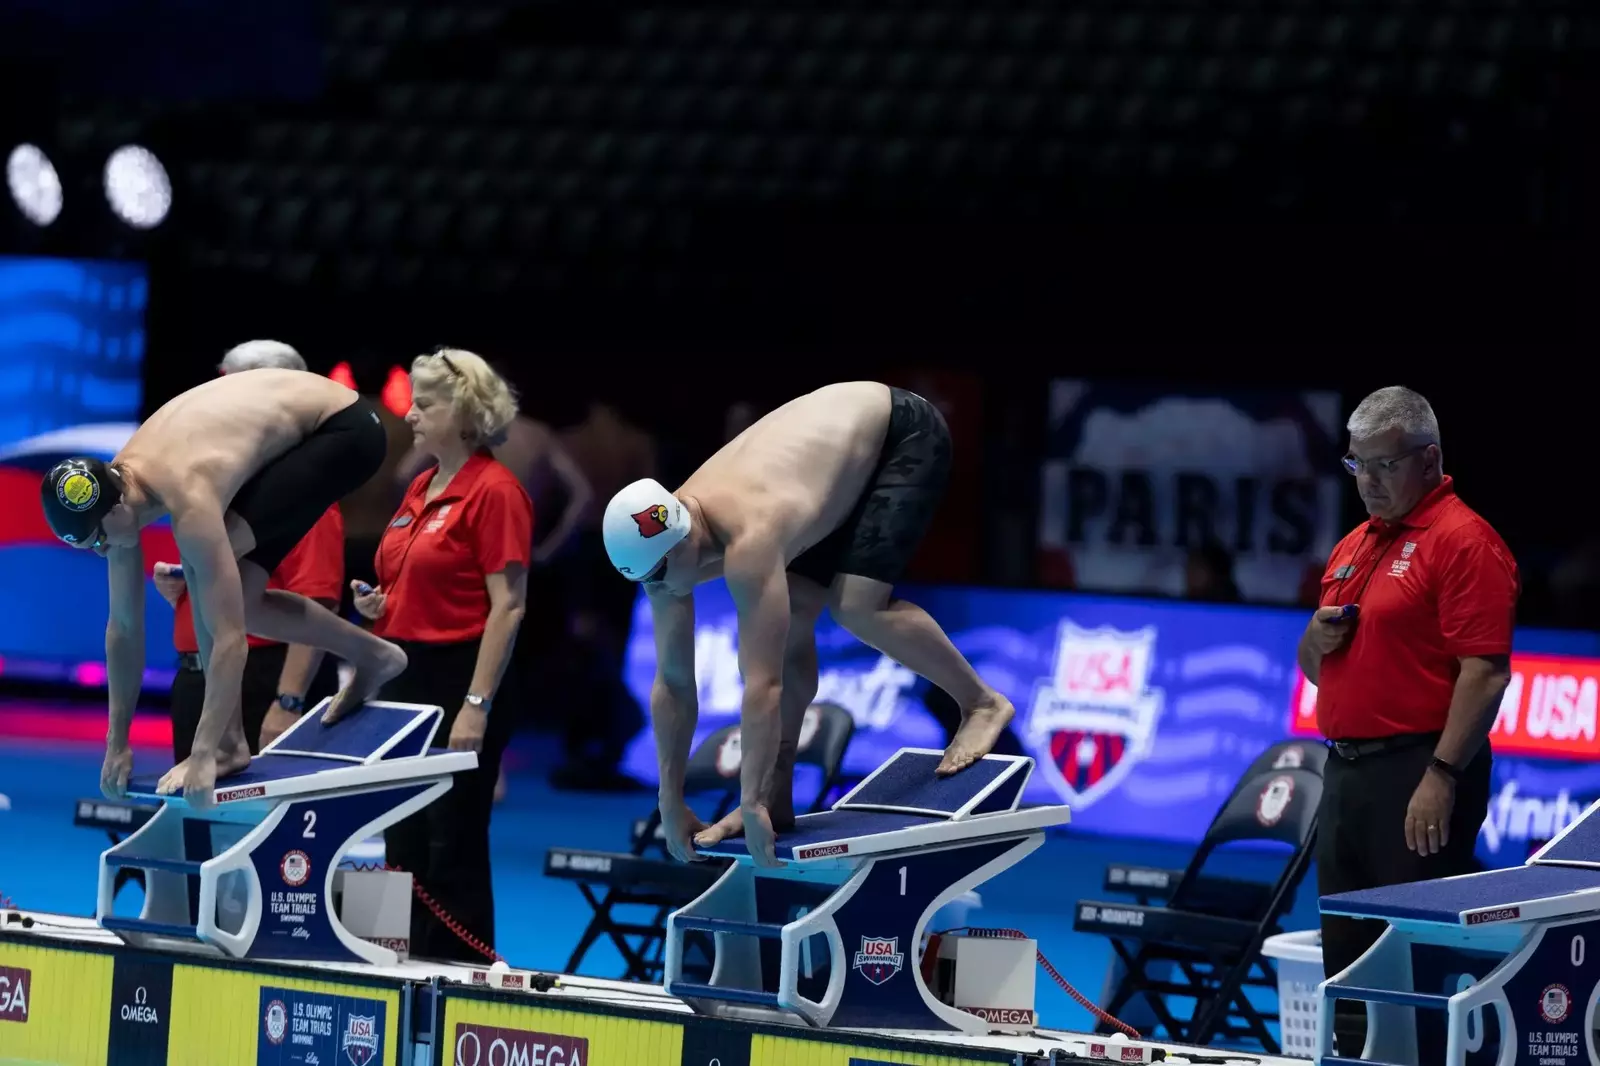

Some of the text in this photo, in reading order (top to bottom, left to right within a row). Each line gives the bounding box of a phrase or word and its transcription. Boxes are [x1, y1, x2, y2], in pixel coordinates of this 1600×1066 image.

[1068, 466, 1317, 555] PARIS
[1526, 673, 1598, 741] USA
[230, 787, 261, 800] OMEGA
[303, 810, 317, 838] 2
[813, 846, 843, 857] OMEGA
[899, 866, 907, 896] 1
[271, 891, 317, 903] U.S. OLYMPIC
[271, 903, 316, 914] TEAM TRIALS
[1482, 910, 1515, 922] OMEGA
[865, 942, 893, 956] USA
[1570, 934, 1585, 967] 0
[857, 955, 899, 964] SWIMMING
[121, 1004, 158, 1024] OMEGA
[293, 1002, 333, 1020] U.S. OLYMPIC
[292, 1018, 332, 1036] TEAM TRIALS
[351, 1020, 371, 1036] USA
[1528, 1032, 1578, 1044] U.S. OLYMPIC
[1528, 1045, 1578, 1057] TEAM TRIALS
